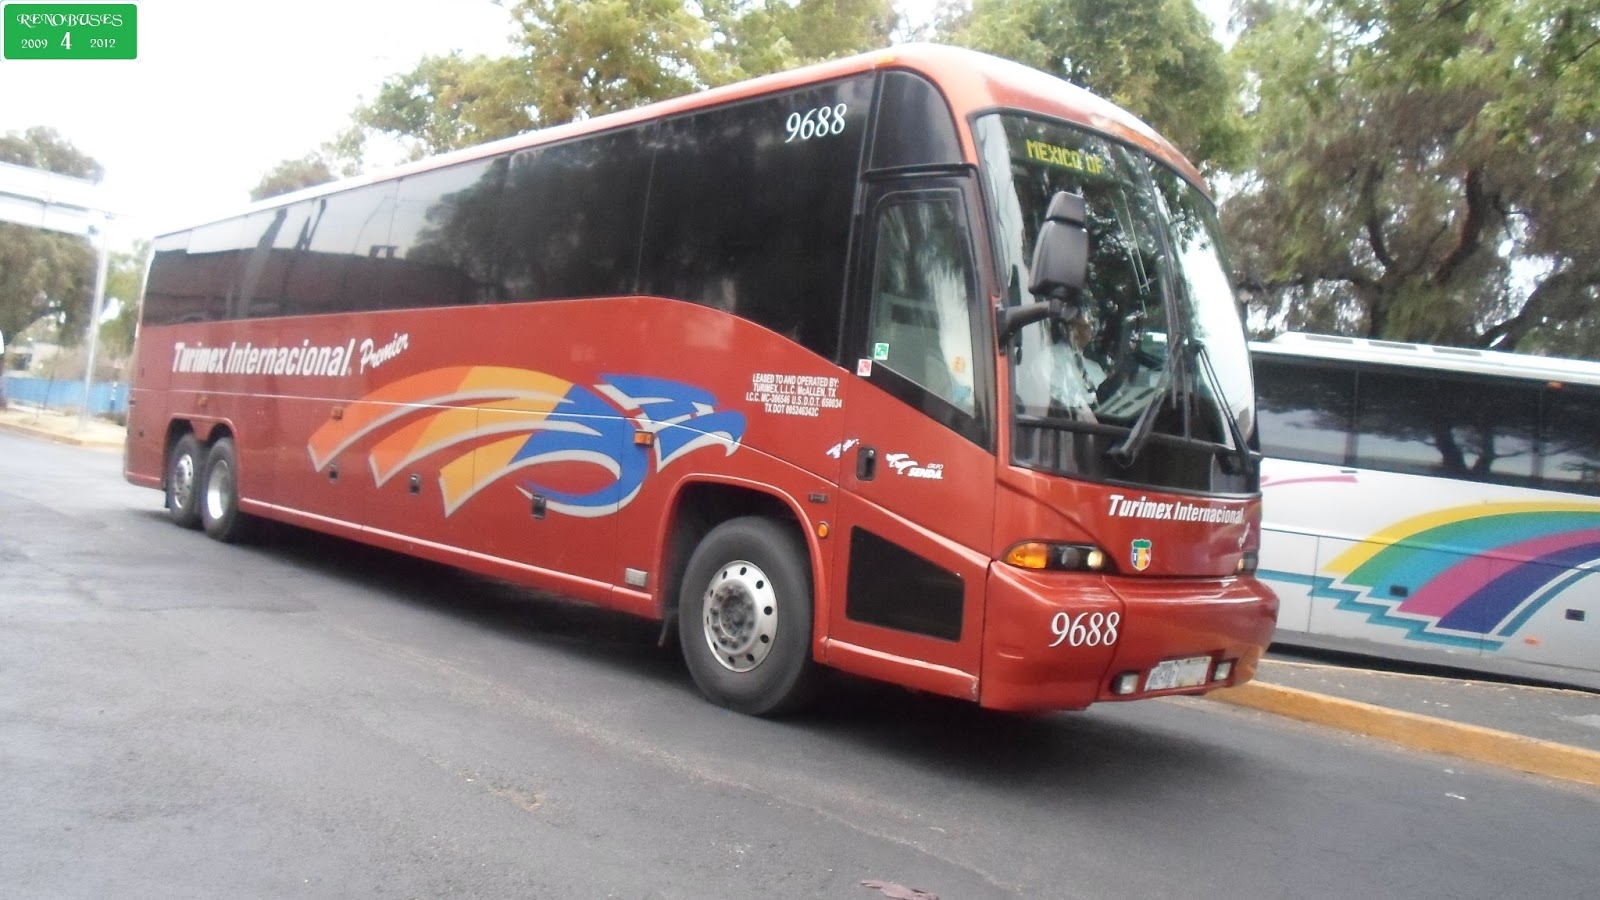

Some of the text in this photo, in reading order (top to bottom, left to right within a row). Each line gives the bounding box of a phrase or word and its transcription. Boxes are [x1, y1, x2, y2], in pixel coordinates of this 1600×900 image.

[784, 103, 848, 143] 9688
[1026, 139, 1083, 170] MEXICO
[172, 333, 409, 376] Turimex Internacional Premier
[752, 373, 840, 388] LEASED TO AND OPERATED BY:
[828, 388, 836, 397] TX
[764, 403, 773, 413] TX
[773, 404, 785, 413] DOT
[908, 468, 944, 480] SENDA
[1108, 494, 1245, 524] Turimex Internacional
[1049, 611, 1120, 647] 9688
